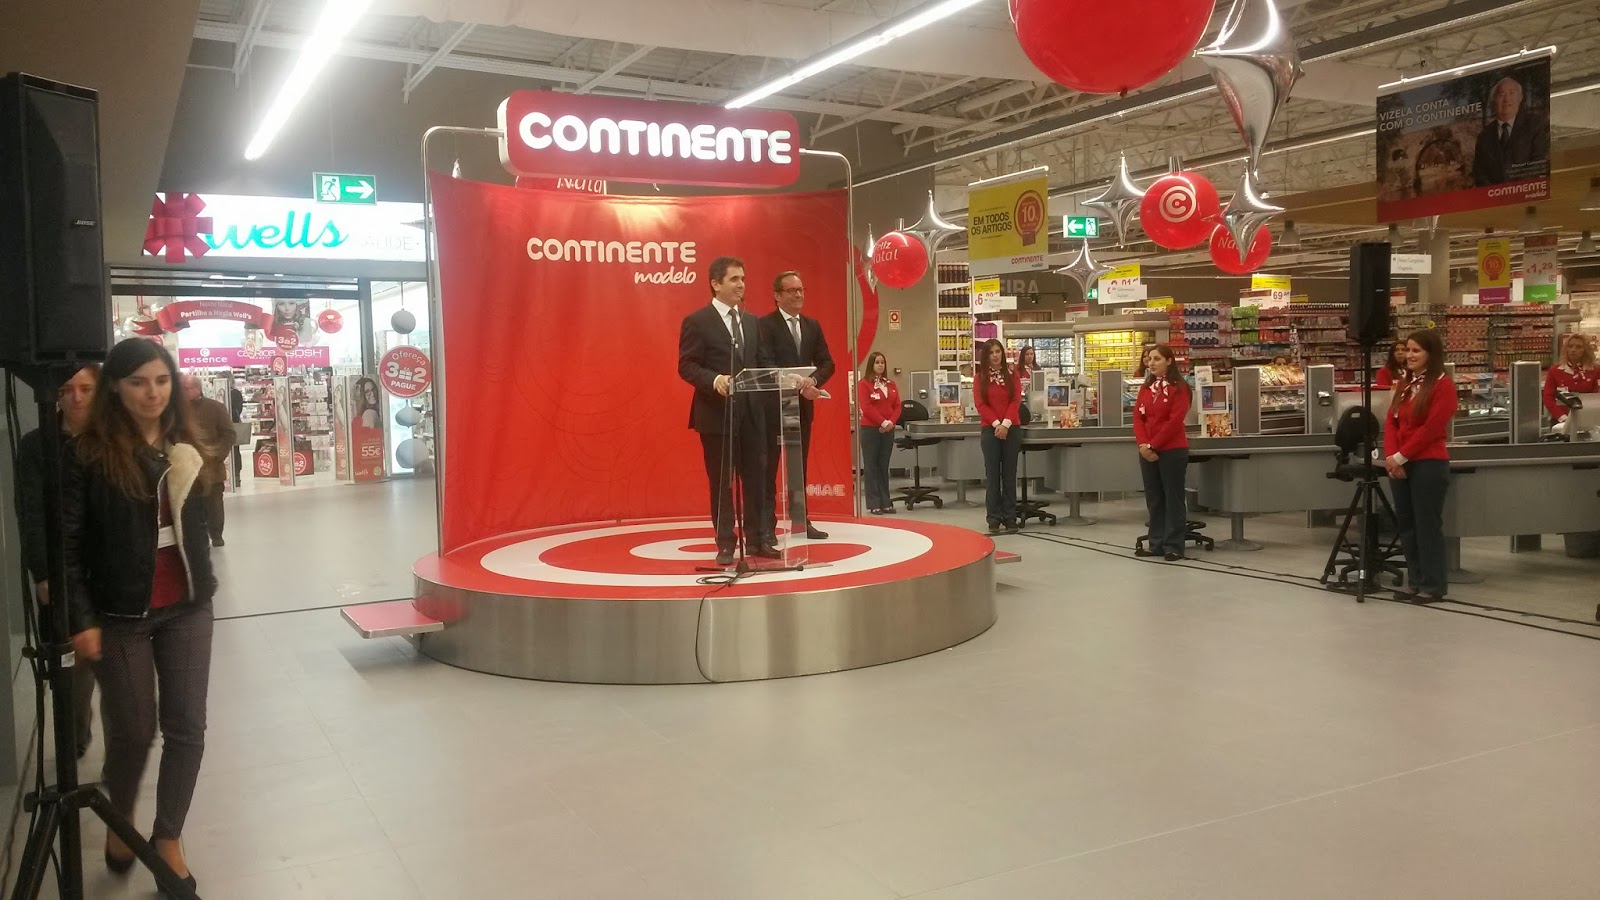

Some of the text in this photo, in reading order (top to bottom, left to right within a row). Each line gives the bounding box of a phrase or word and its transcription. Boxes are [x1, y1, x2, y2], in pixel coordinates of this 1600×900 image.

[1380, 98, 1450, 120] VIZELA CONTA
[1380, 101, 1482, 132] COM O CONTINENTE
[519, 112, 792, 164] CONTINENTE
[1487, 181, 1547, 197] CONTINENTE
[973, 211, 1010, 226] EM TODOS
[971, 226, 981, 236] OS
[981, 221, 1013, 235] ARTIGOS
[526, 237, 697, 263] CONTINENTE
[633, 265, 697, 284] modelo
[183, 355, 228, 364] essence
[391, 350, 426, 367] Ofereça
[384, 361, 427, 384] 3 2
[390, 380, 417, 391] PAGUE
[361, 445, 381, 457] 55€
